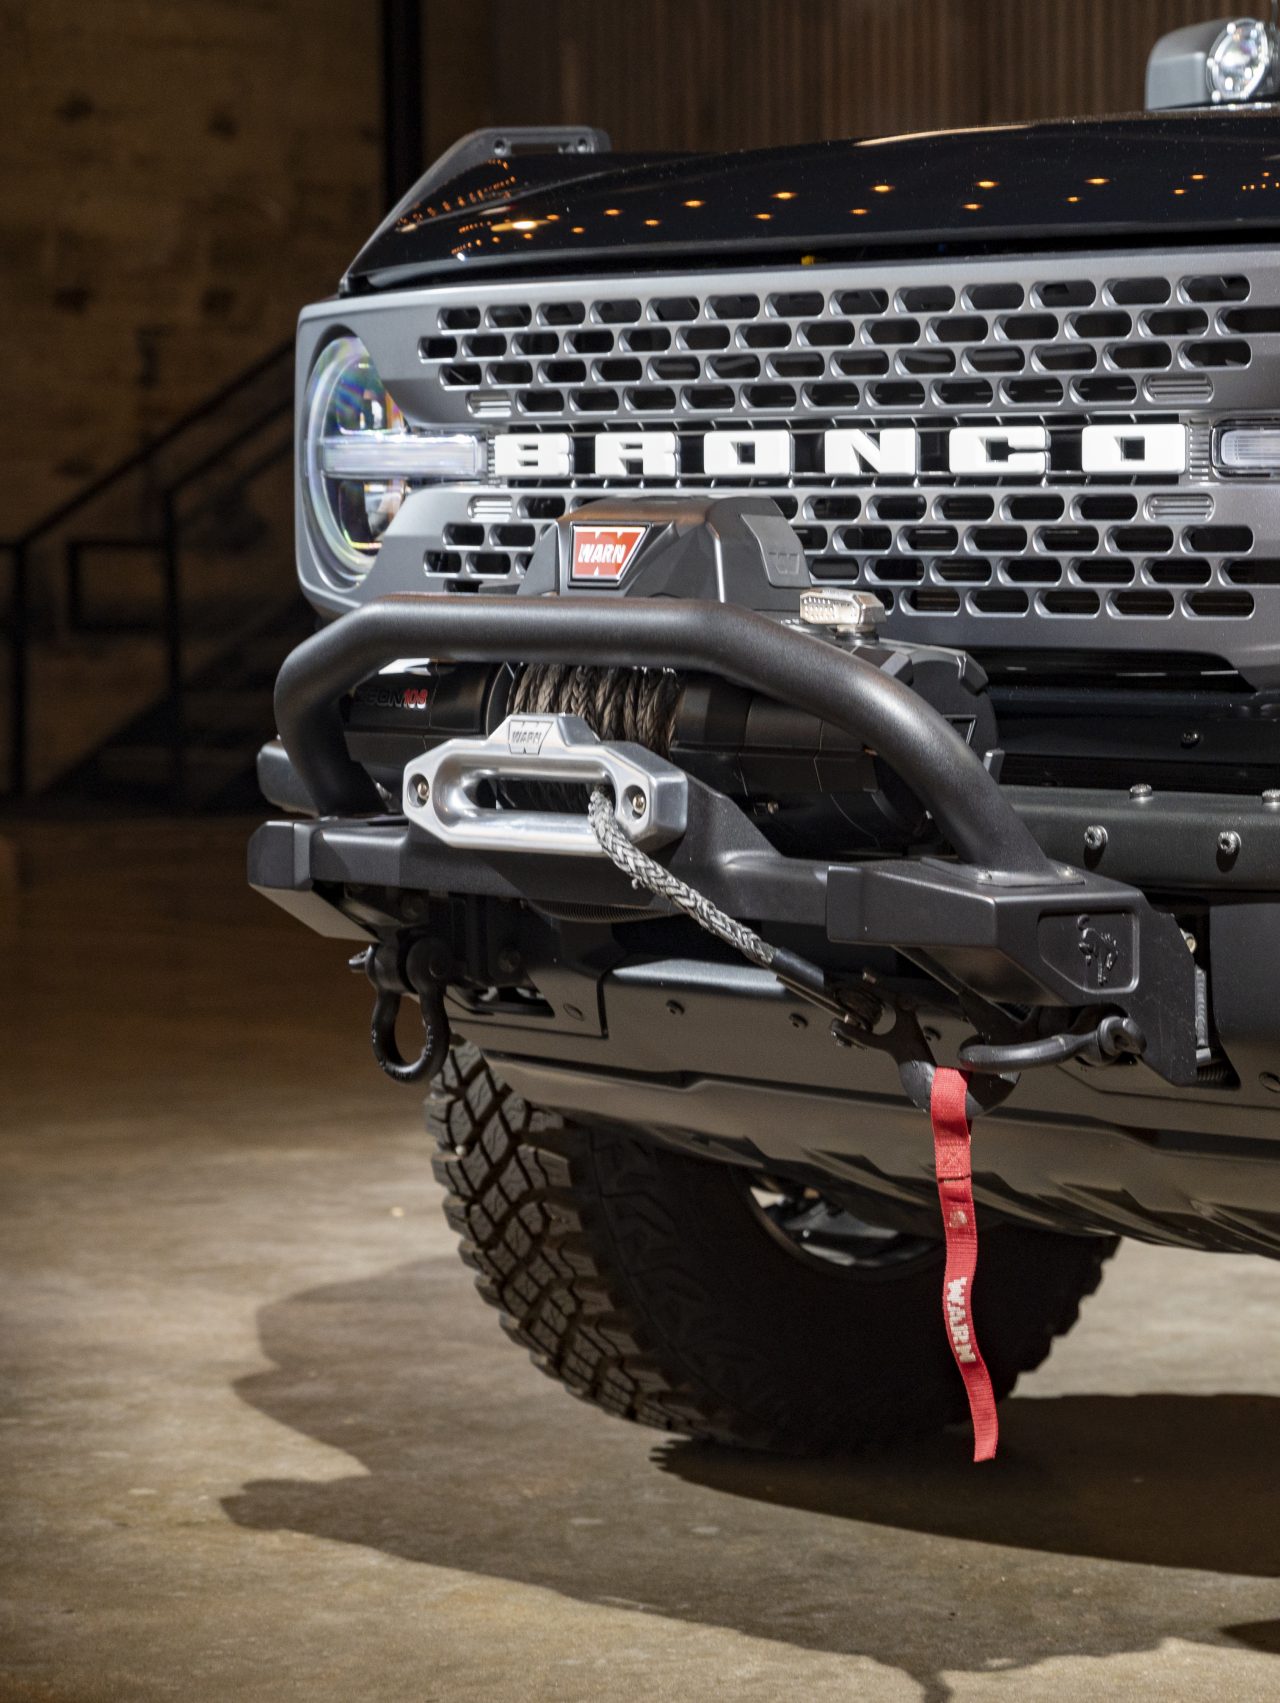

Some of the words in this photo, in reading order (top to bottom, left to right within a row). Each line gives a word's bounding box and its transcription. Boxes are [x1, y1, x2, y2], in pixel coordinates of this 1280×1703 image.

[495, 424, 1189, 477] BRONCO
[577, 543, 627, 563] WARN
[511, 730, 542, 744] WARN
[947, 1277, 976, 1363] WARN
